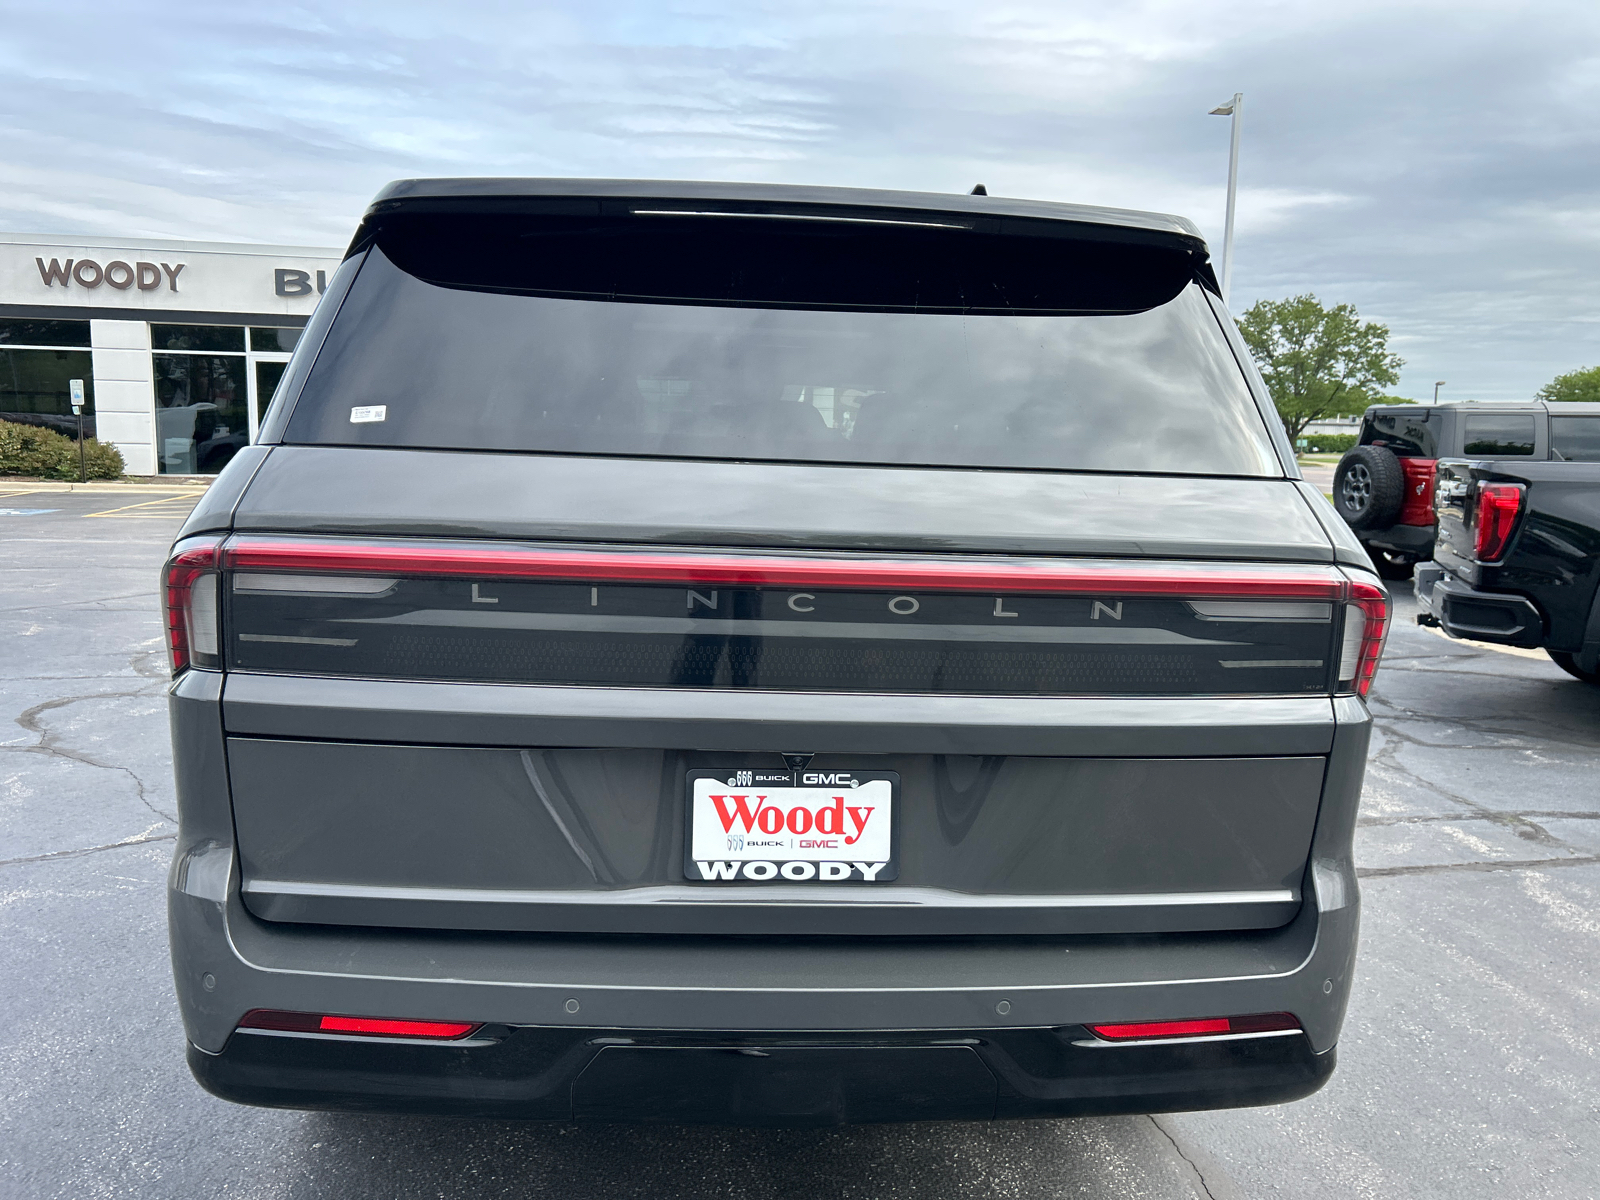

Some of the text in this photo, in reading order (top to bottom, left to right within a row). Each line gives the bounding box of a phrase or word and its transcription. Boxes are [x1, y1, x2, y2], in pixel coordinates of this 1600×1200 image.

[35, 257, 186, 293] WOODY
[471, 583, 1124, 620] LINCOLN
[755, 773, 851, 785] BUICK GMC
[708, 795, 875, 845] Woody
[799, 839, 838, 849] GMC
[696, 860, 887, 882] WOODY
